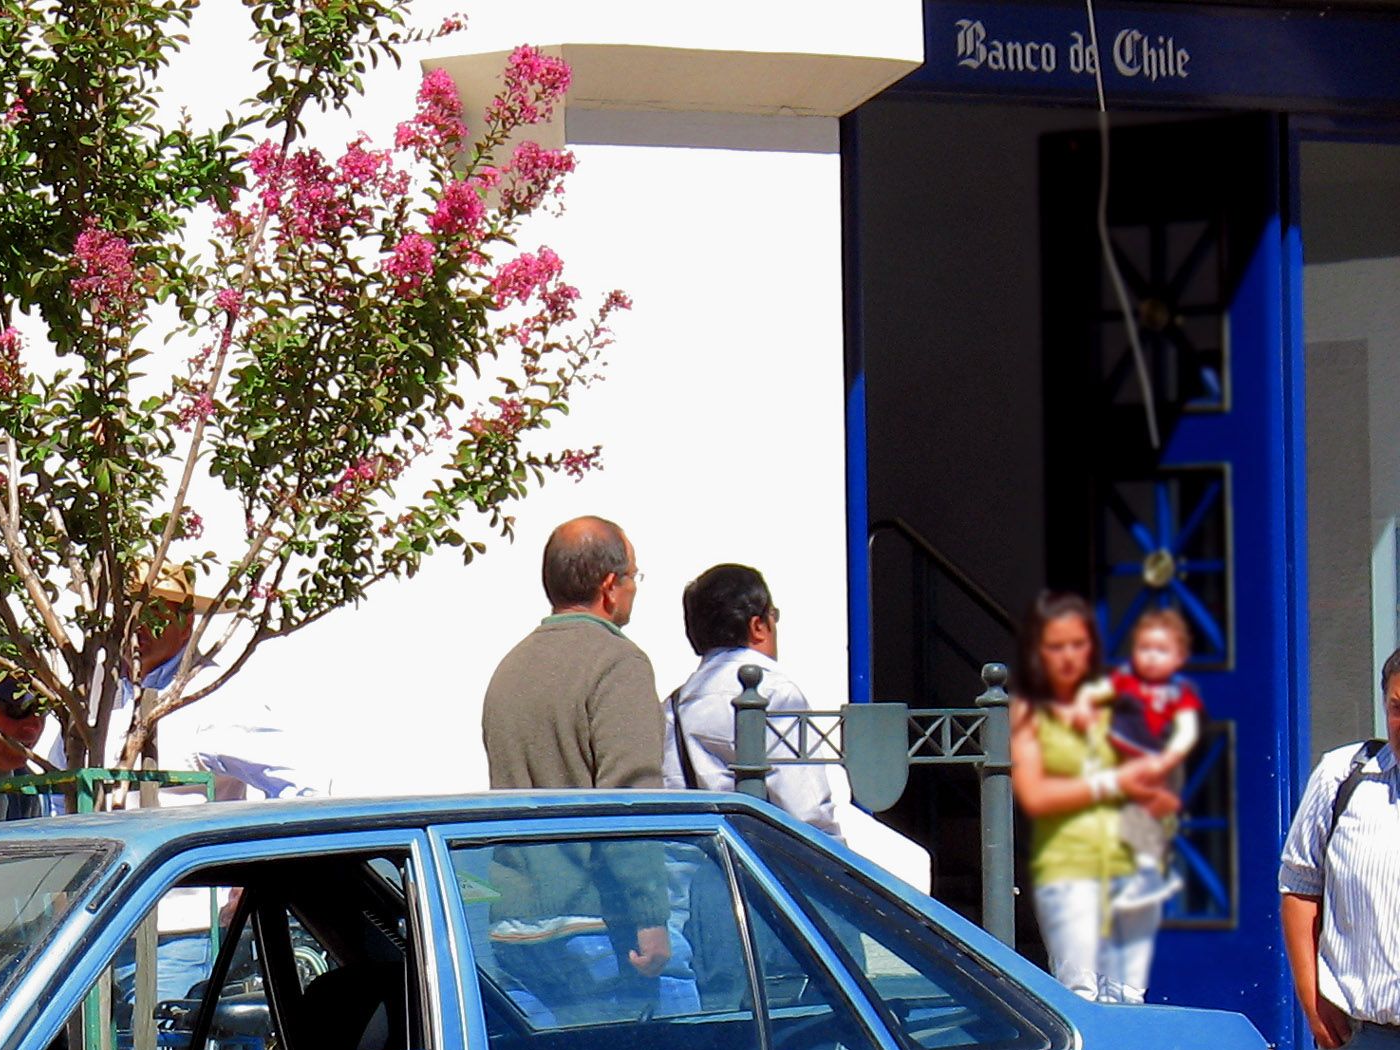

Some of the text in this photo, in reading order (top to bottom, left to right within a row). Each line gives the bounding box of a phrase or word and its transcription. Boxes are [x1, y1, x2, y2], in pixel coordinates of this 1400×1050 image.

[955, 19, 1191, 82] Banco de Chile
